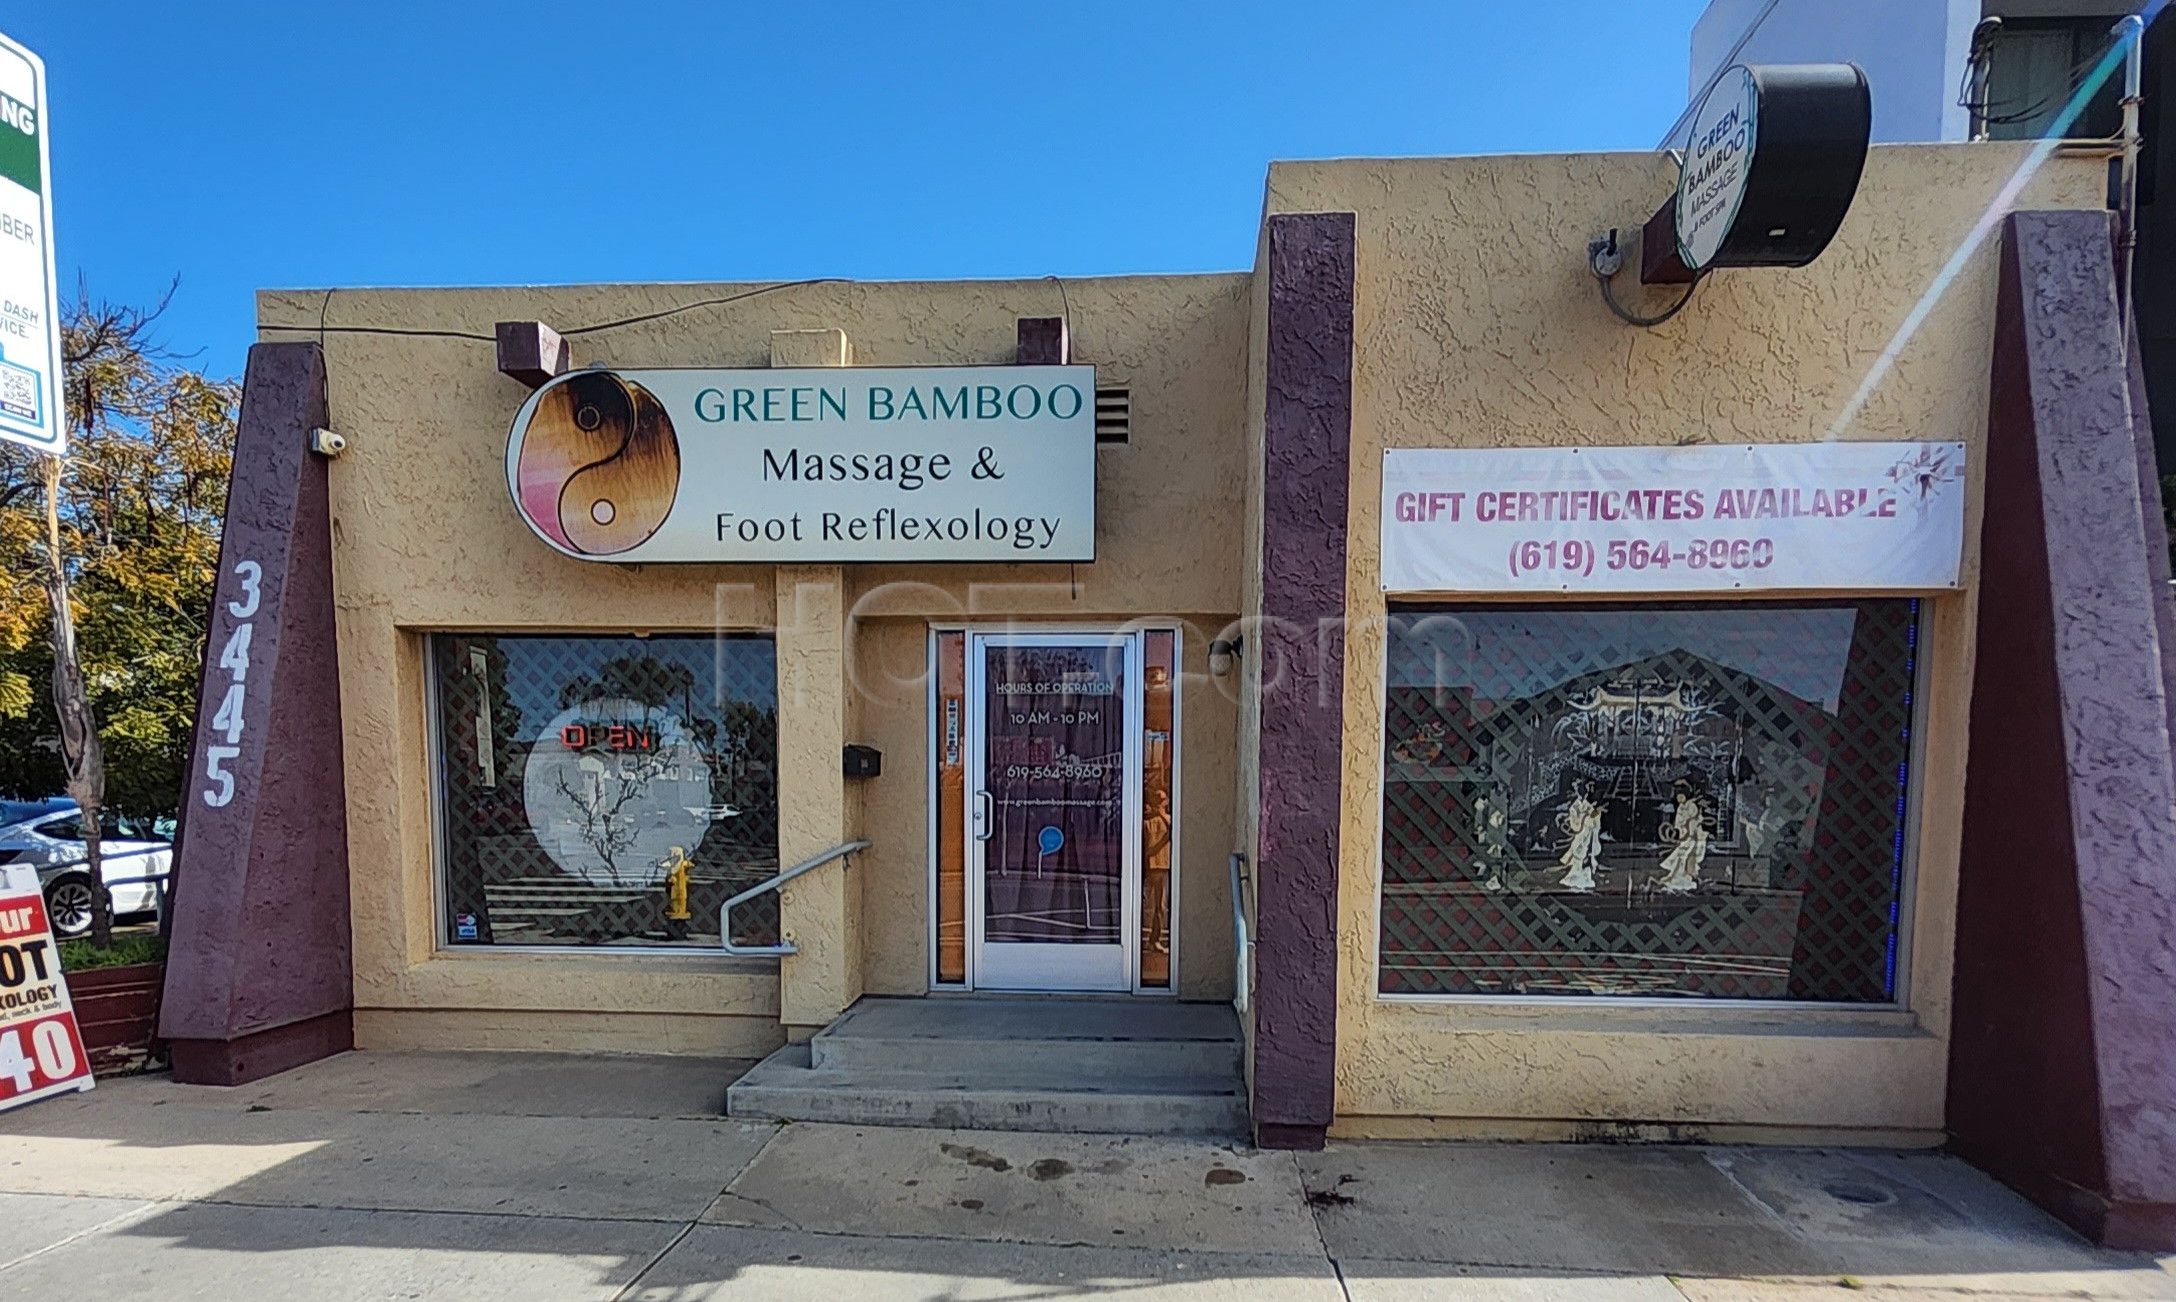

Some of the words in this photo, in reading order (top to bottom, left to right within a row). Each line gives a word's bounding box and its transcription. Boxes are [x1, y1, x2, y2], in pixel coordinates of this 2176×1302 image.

[1697, 102, 1740, 159] GREEN
[1688, 127, 1746, 195] BAMBOO
[1691, 160, 1739, 218] MASSAGE
[0, 213, 35, 246] BER
[4, 299, 39, 325] DASH
[694, 387, 847, 423] GREEN
[868, 384, 1083, 421] BAMBOO
[762, 447, 952, 491] Massage
[971, 446, 1006, 481] &
[1395, 491, 1466, 522] GIFT
[1476, 489, 1704, 523] CERTIFICATES
[1713, 488, 1896, 519] AVAILABLE
[716, 510, 803, 542] Foot
[821, 508, 1061, 549] Reflexology
[1509, 539, 1595, 577] (619)
[1606, 538, 1774, 571] 564-8960
[203, 559, 263, 807] 3445
[996, 682, 1033, 695] HOURS
[1035, 682, 1051, 695] OF
[1053, 682, 1114, 695] OPERATION
[560, 725, 650, 750] OPEN
[1011, 713, 1026, 725] 10
[1028, 711, 1051, 725] AM
[1061, 713, 1075, 725] 10
[1078, 711, 1099, 725] PM
[1007, 764, 1103, 779] 619-564-8960
